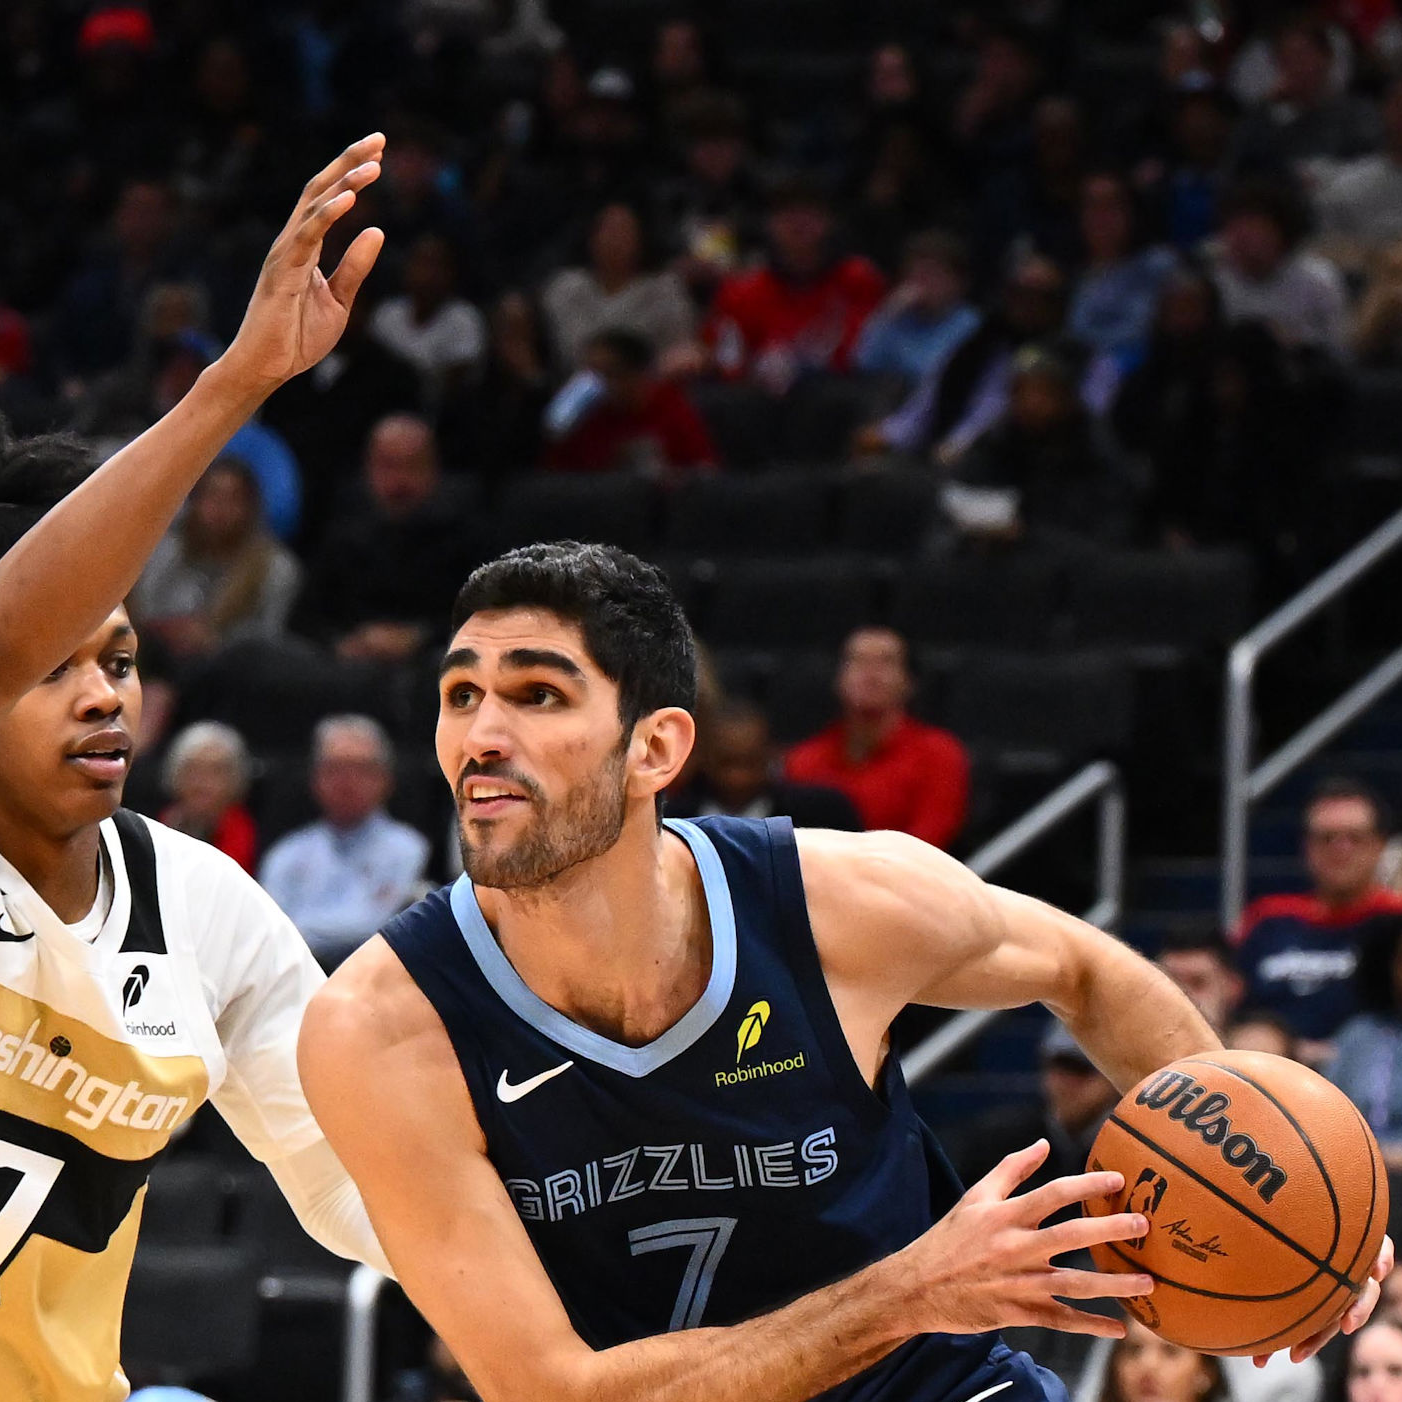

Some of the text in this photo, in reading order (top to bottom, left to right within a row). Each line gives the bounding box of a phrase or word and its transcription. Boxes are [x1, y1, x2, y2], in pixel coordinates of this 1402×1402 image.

[715, 1051, 805, 1087] Robinhood
[505, 1126, 839, 1222] GRIZZLIES
[1136, 1070, 1287, 1204] Wilson
[628, 1216, 738, 1332] 7
